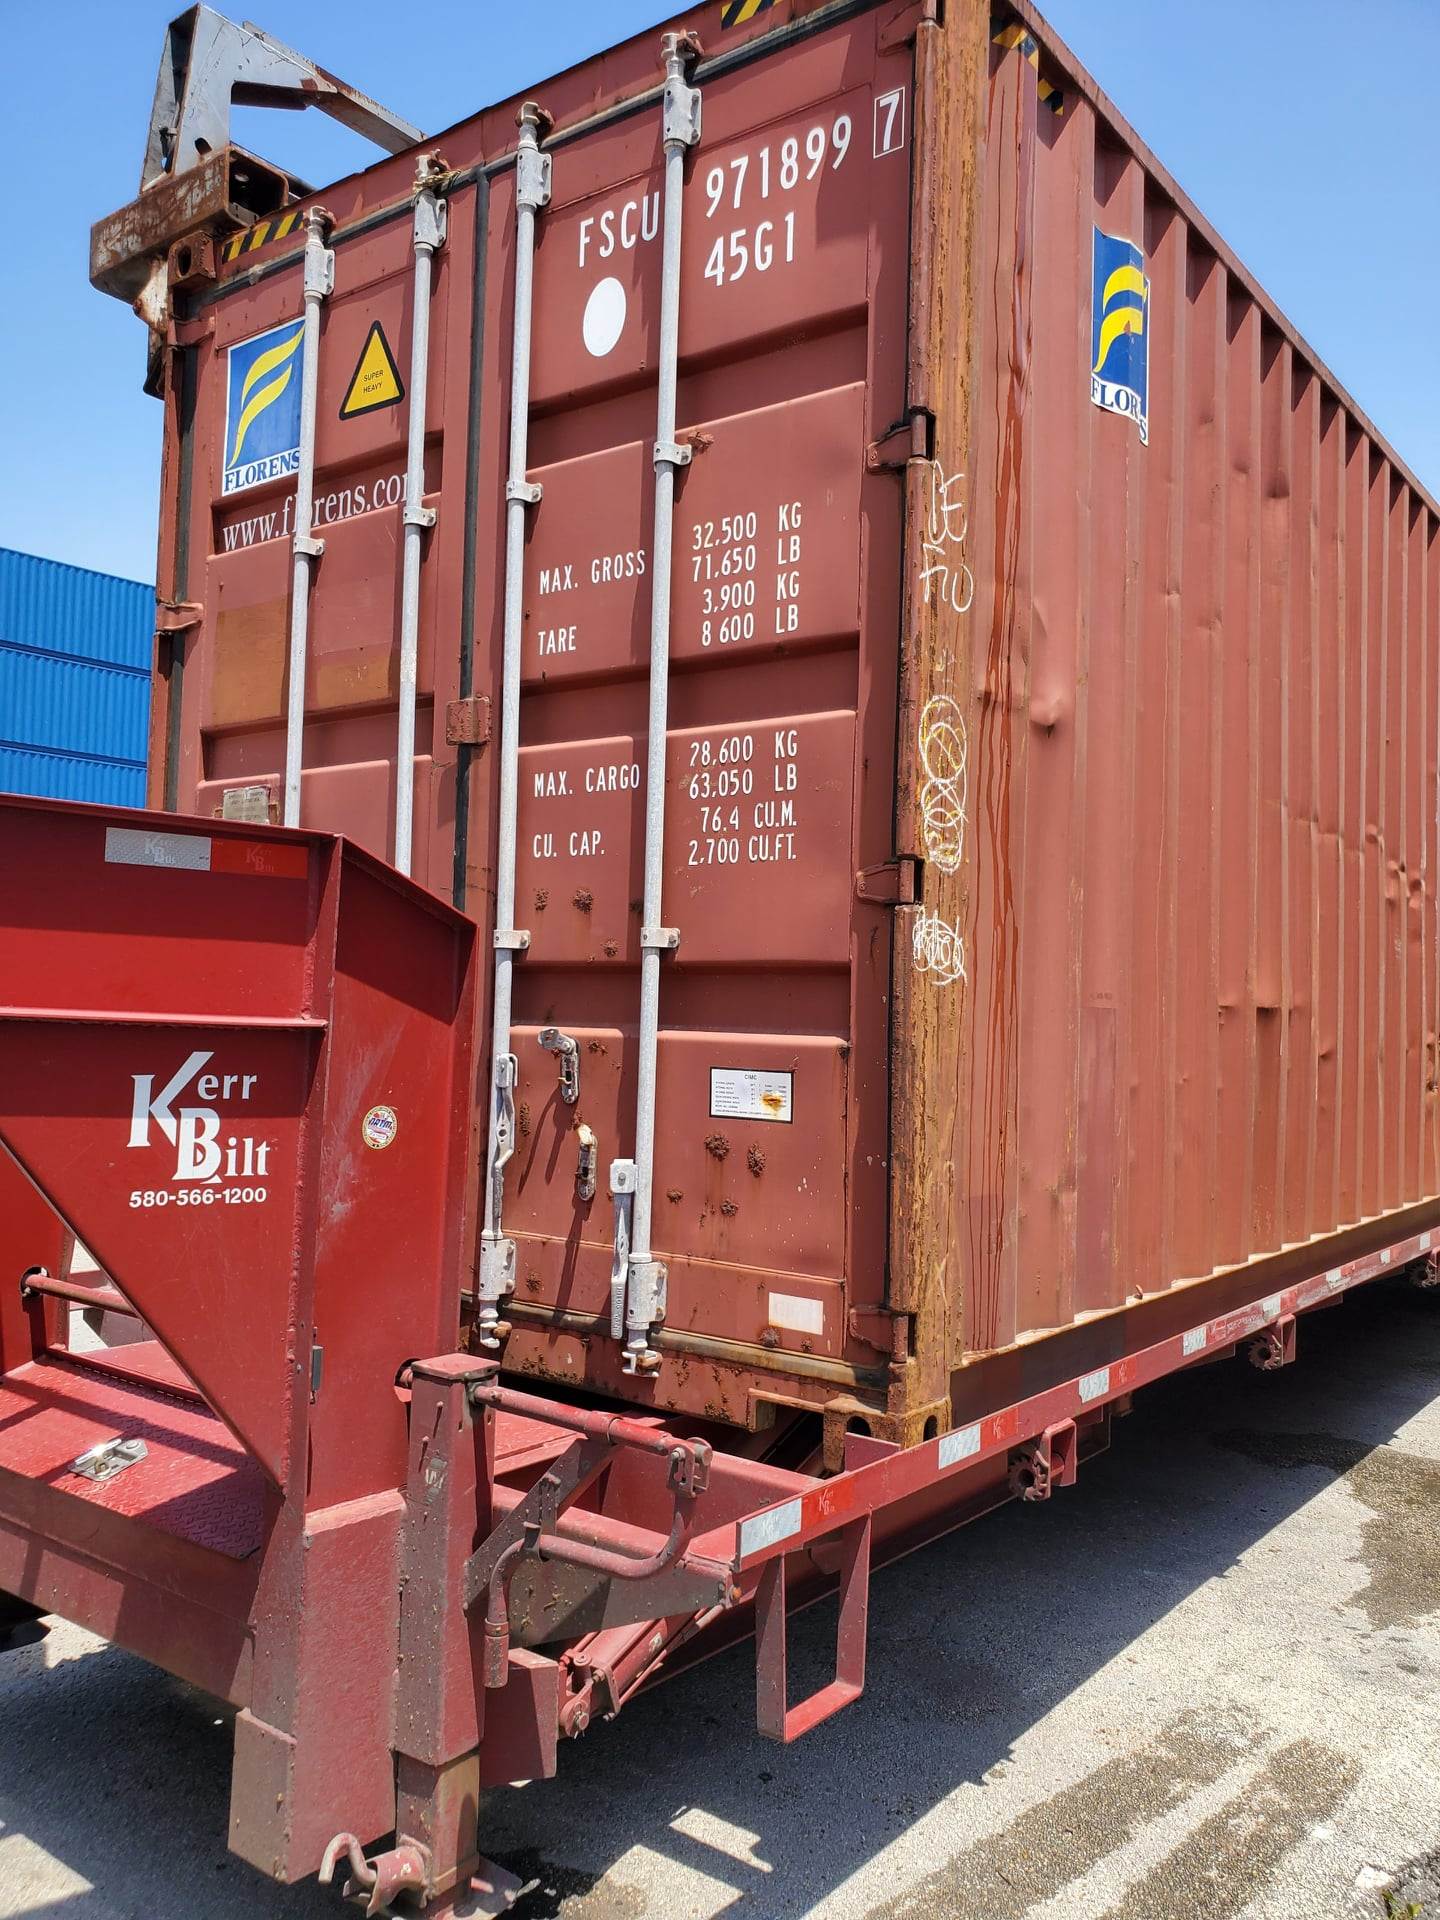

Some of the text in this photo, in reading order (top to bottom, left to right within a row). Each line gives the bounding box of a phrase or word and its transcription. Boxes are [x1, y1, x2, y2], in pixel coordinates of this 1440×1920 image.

[578, 92, 900, 268] FSCU 971899 7
[704, 211, 795, 286] 45G1
[363, 369, 384, 382] SUPER
[363, 382, 383, 393] HEAVY
[224, 450, 300, 492] FLORENS
[223, 472, 425, 552] www.frens.co
[692, 501, 802, 550] 32,500 KG
[539, 550, 646, 595] MAX. GROSS
[692, 535, 801, 582] 71,650 LB
[702, 571, 800, 614] 3,900 KG
[775, 604, 799, 634] LB
[538, 626, 577, 656] TARE
[690, 730, 798, 767] 28,600 KG
[534, 764, 640, 797] MAX. CARGO
[689, 763, 798, 800] 63,050 LB
[700, 800, 797, 833] 76.4 CU.M.
[533, 831, 605, 858] CU. CAP.
[688, 838, 740, 866] 2,700
[126, 1051, 258, 1148] Kerr
[172, 1107, 271, 1184] Bilt
[128, 1187, 268, 1209] 580-566-1200
